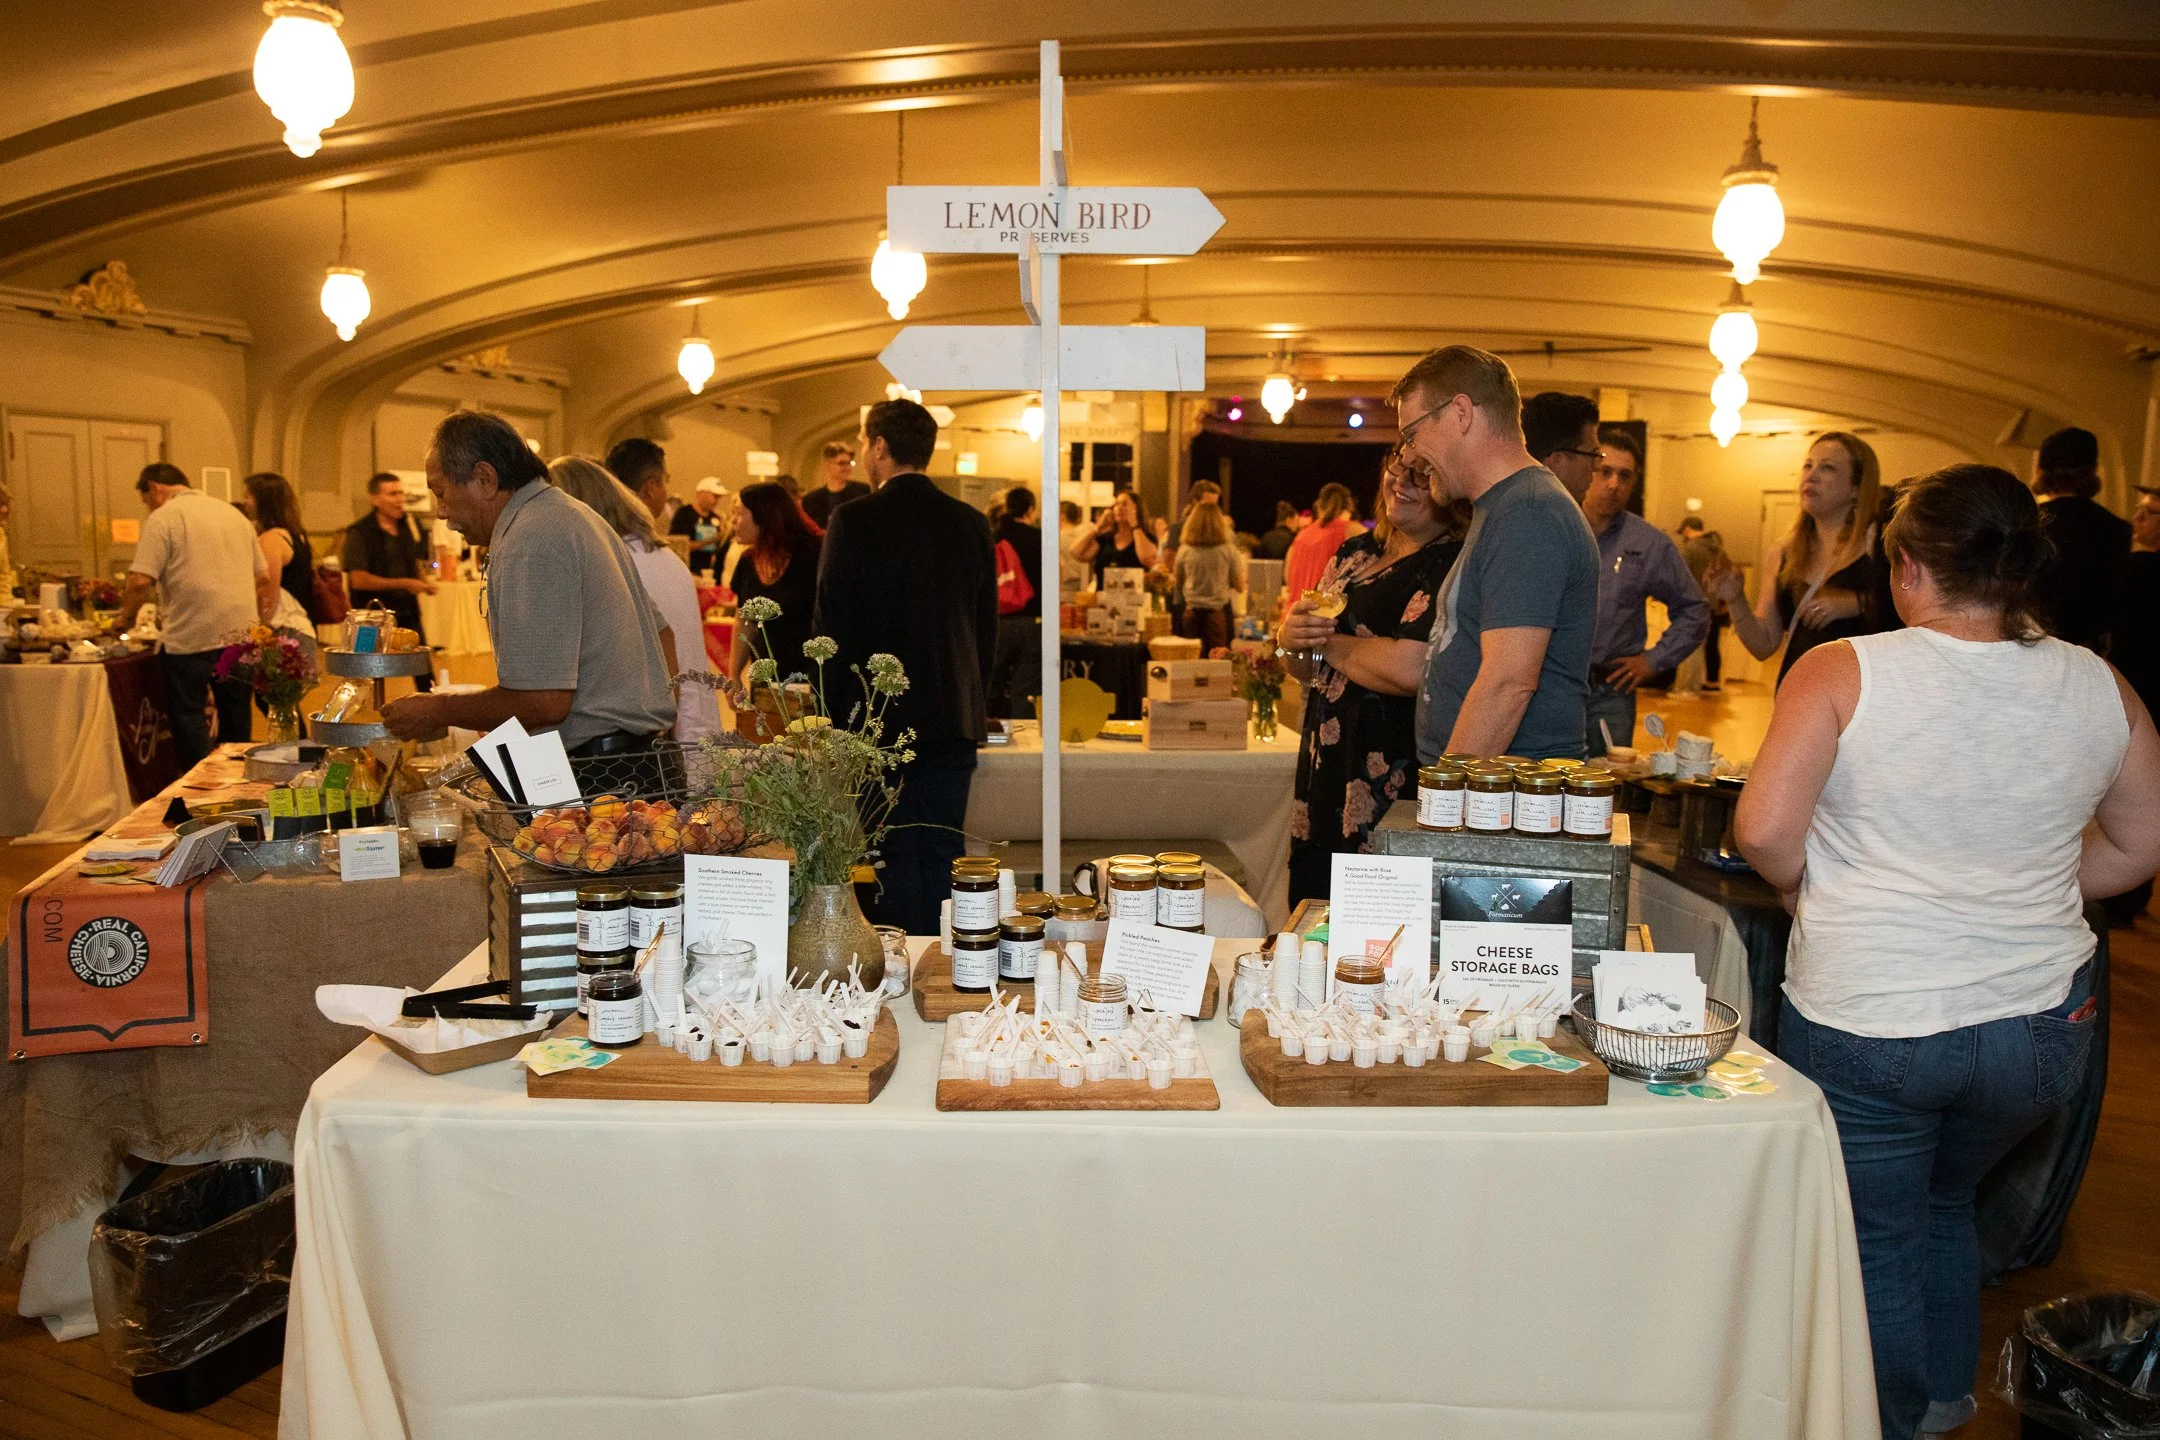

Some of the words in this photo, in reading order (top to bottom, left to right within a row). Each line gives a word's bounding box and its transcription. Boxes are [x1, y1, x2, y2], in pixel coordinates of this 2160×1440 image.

[944, 201, 1059, 229] LEMON
[1077, 201, 1151, 230] BIRD
[1000, 231, 1090, 243] PRSERVES
[1488, 911, 1523, 919] Formaticum
[92, 919, 129, 932] REAL
[1122, 931, 1140, 940] Pickled
[1140, 935, 1160, 944] Peaches
[70, 930, 92, 980] CHEESE
[95, 931, 147, 986] CALIFORNIA
[1477, 946, 1533, 959] CHEESE
[1452, 961, 1517, 974] STORAGE
[1522, 964, 1559, 976] BAGS
